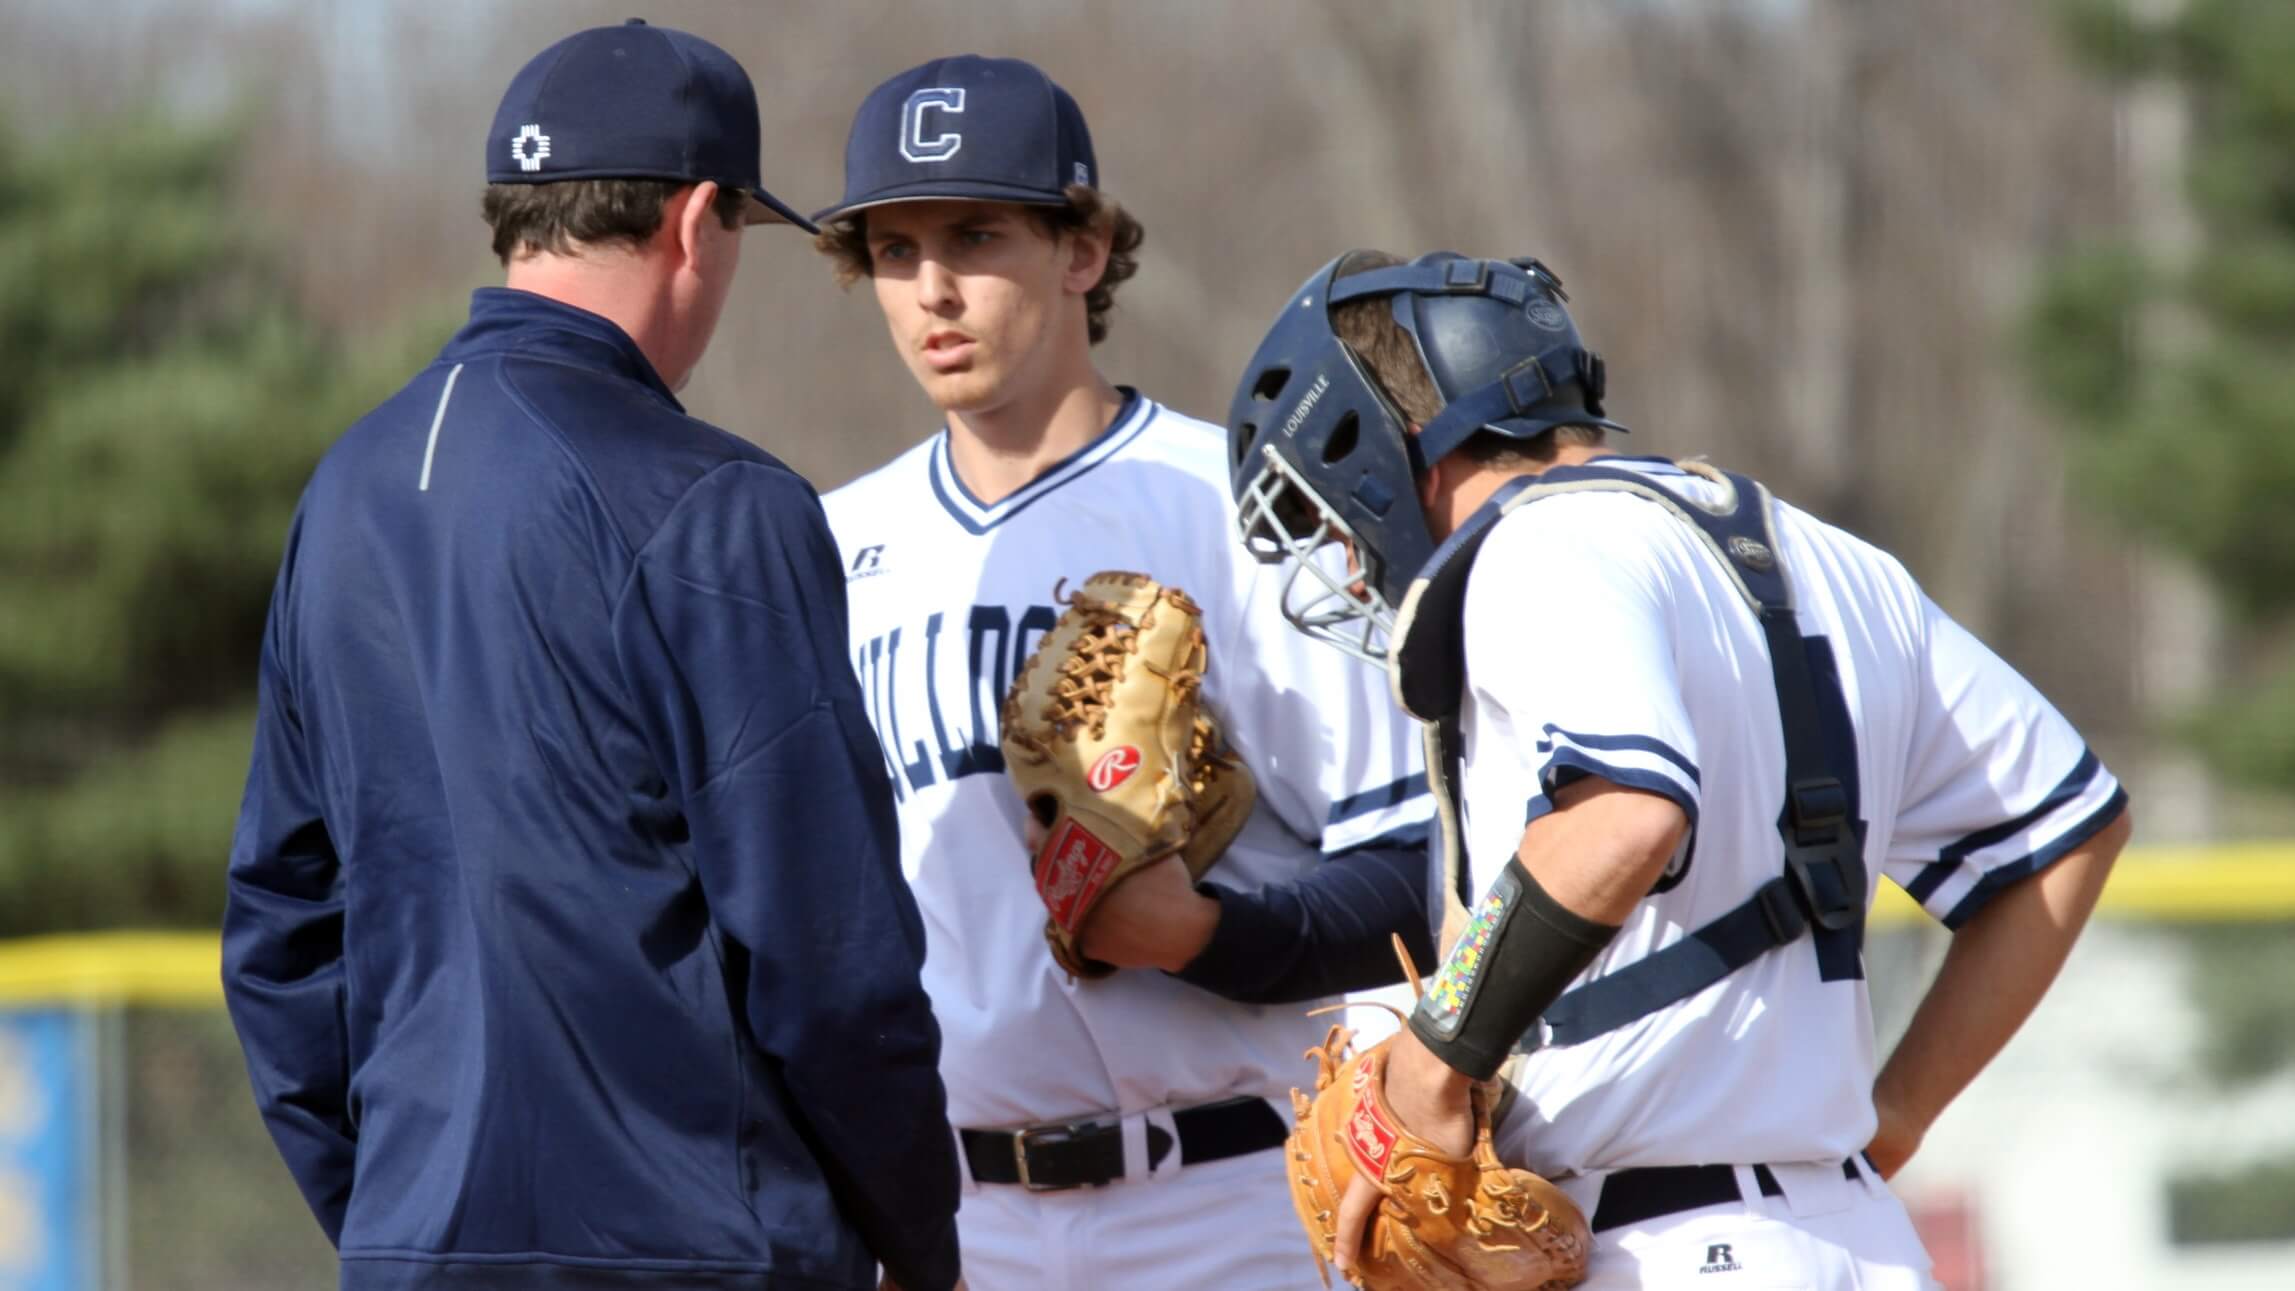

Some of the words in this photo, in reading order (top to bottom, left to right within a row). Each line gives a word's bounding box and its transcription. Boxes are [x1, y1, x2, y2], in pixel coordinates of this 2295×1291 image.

[900, 87, 965, 162] C
[1282, 374, 1330, 438] LOUISVILLE
[1706, 1243, 1734, 1264] R
